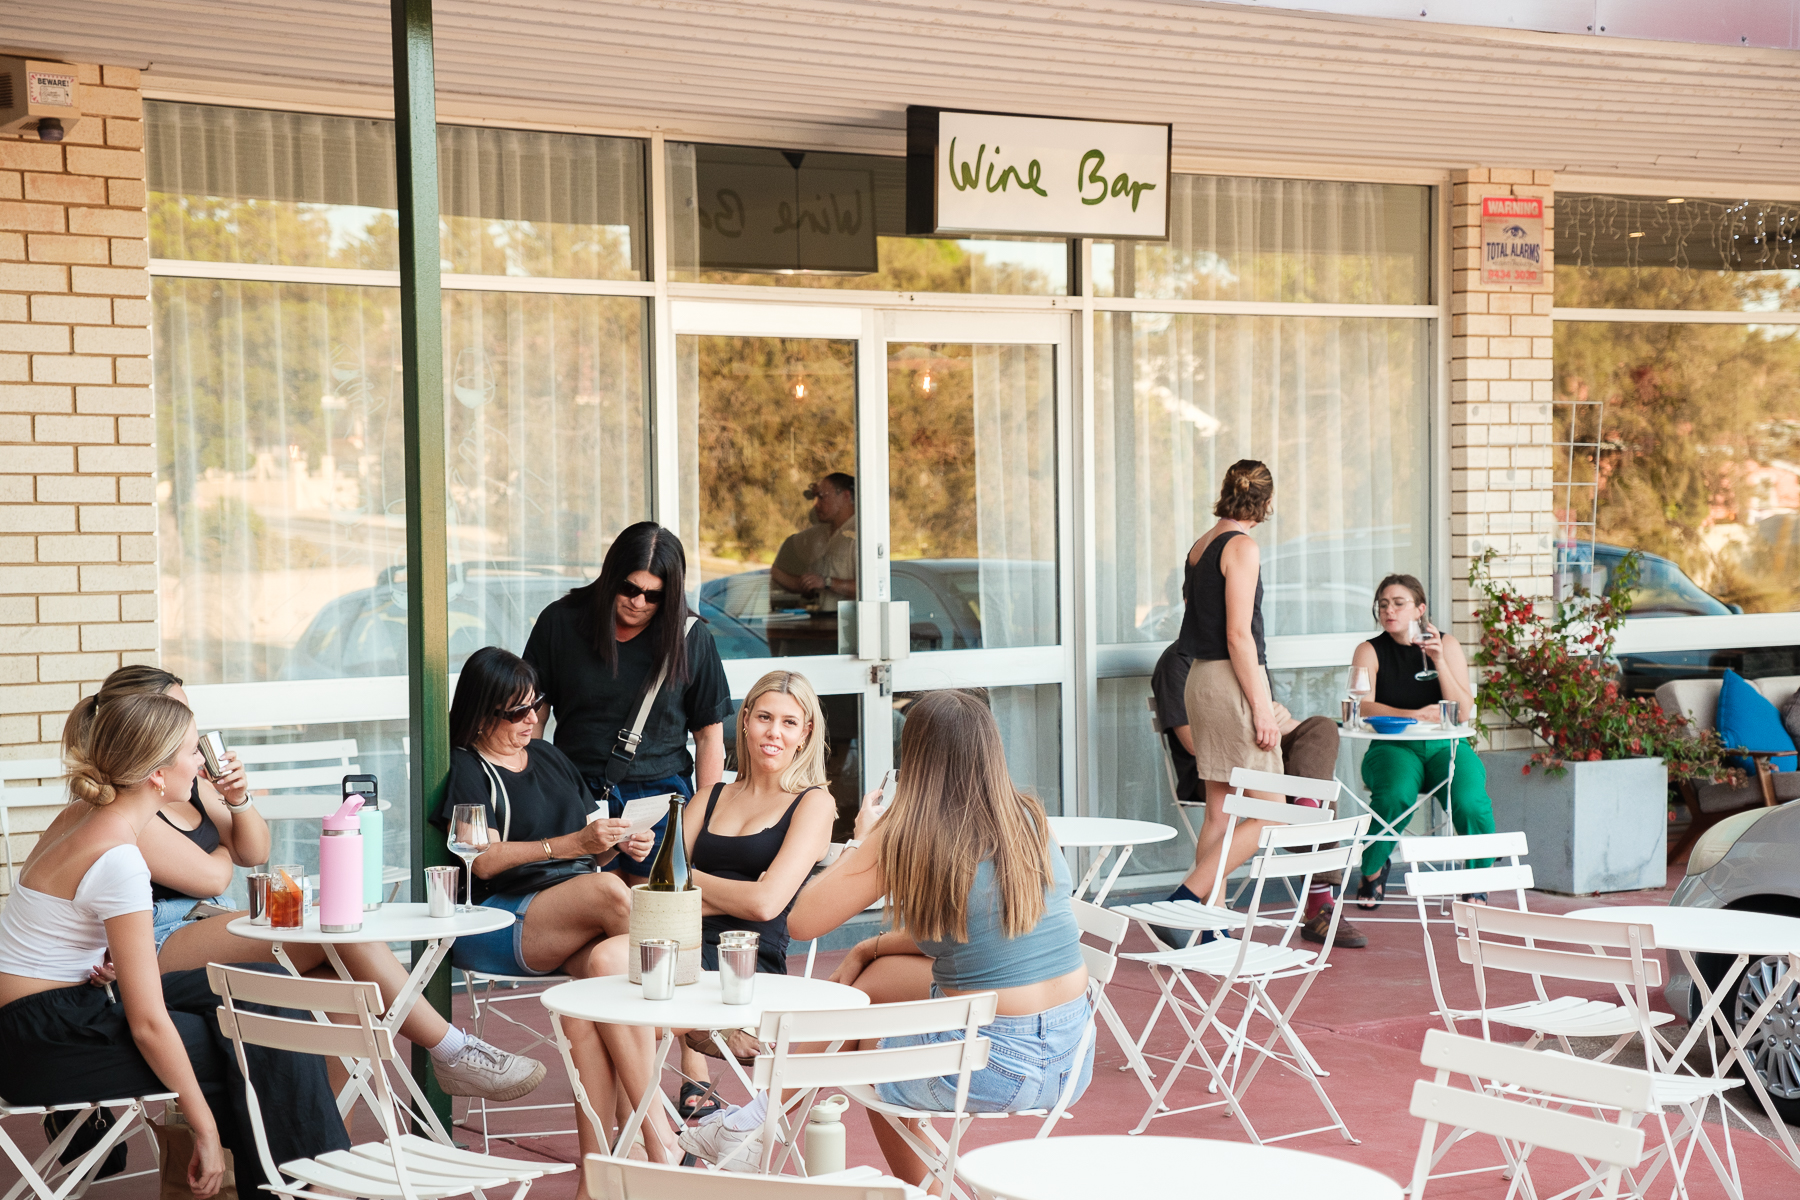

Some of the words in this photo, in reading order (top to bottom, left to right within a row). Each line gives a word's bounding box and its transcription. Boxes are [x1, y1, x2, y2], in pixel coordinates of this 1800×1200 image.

[37, 78, 69, 87] BEWARE!
[949, 136, 1048, 197] Wine
[1078, 149, 1157, 213] Bar
[1488, 201, 1539, 215] WARNING
[1486, 242, 1508, 261] TOTAL
[1511, 242, 1540, 263] ALARMS
